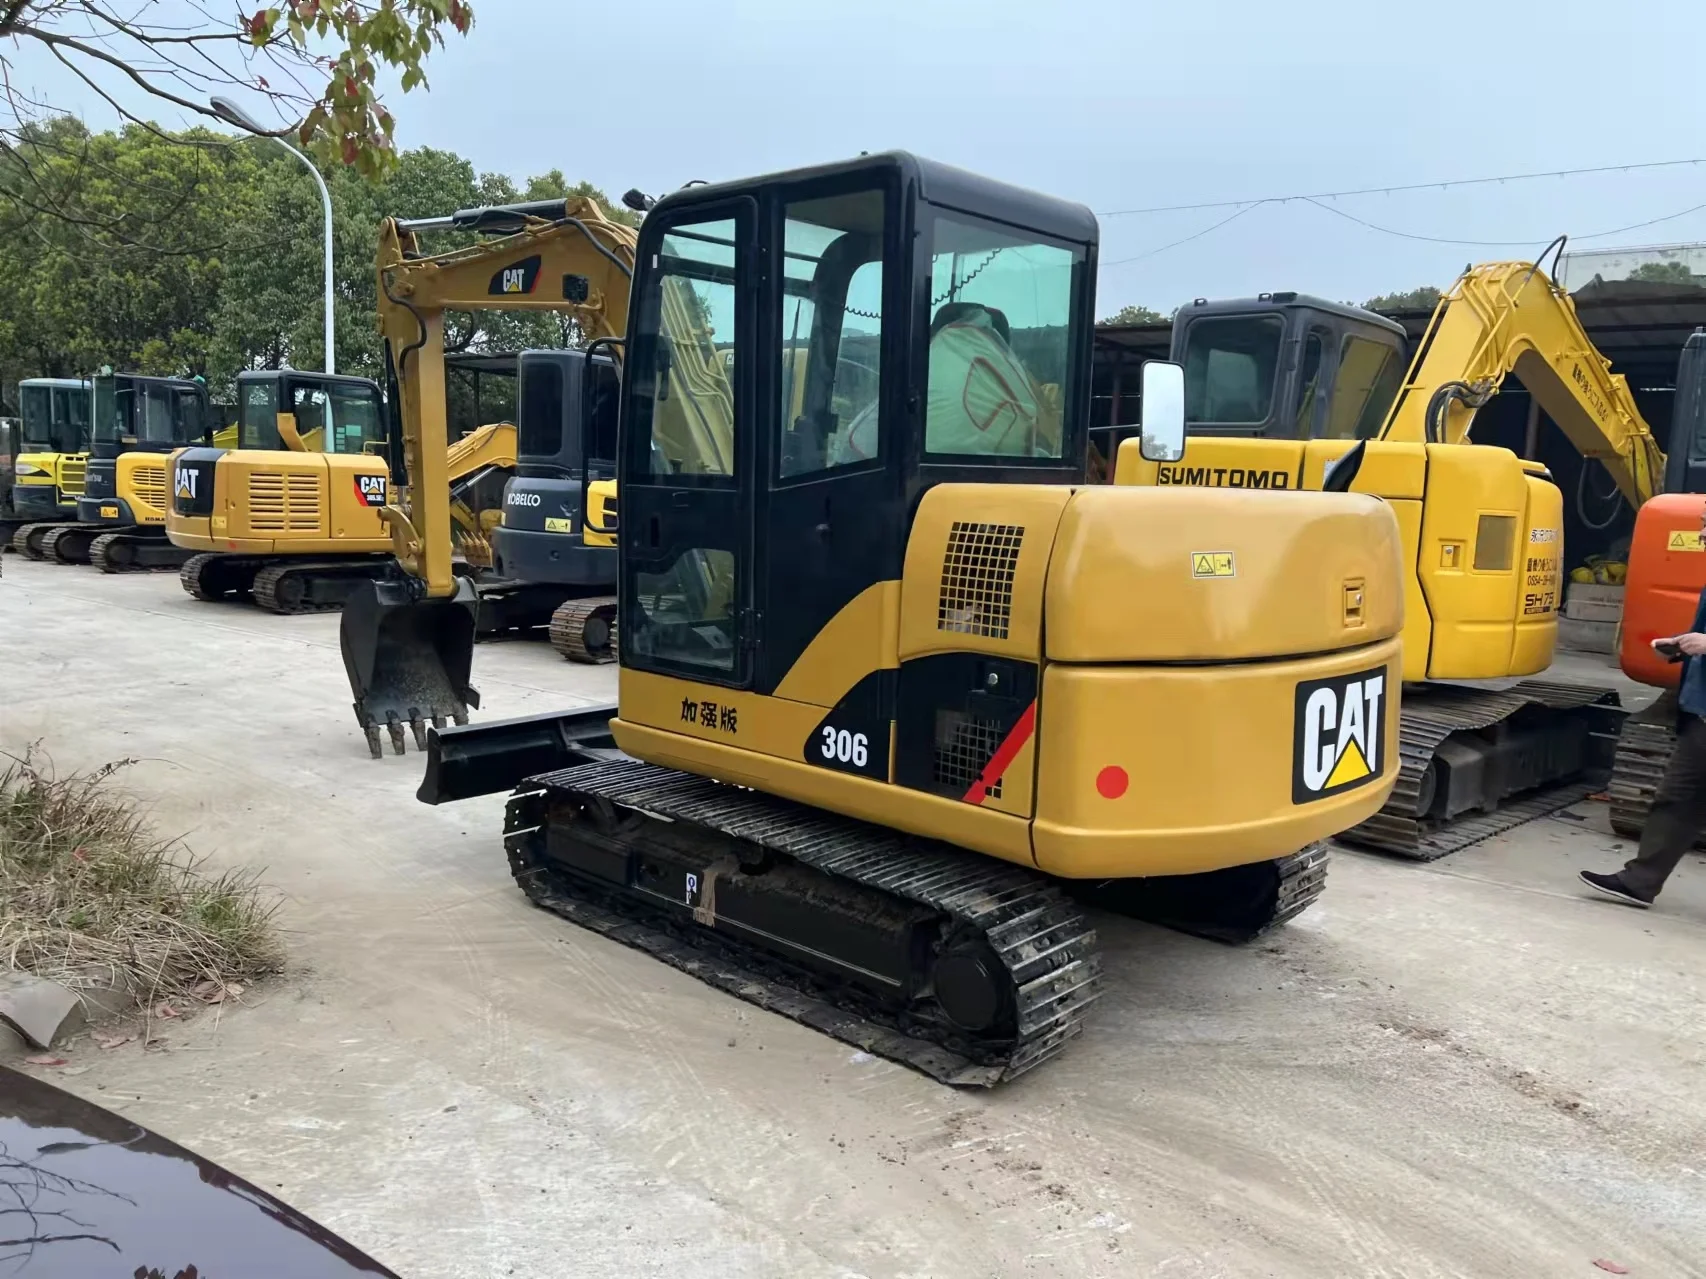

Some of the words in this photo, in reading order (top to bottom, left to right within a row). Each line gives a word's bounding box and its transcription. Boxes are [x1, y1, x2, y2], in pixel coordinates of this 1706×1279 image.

[503, 268, 525, 292] CAT
[174, 467, 199, 499] CAT
[360, 476, 386, 494] CAT
[1159, 467, 1289, 489] SUMITOMO
[680, 696, 738, 735] 加强版
[821, 725, 869, 768] 306
[1303, 675, 1384, 792] CAT
